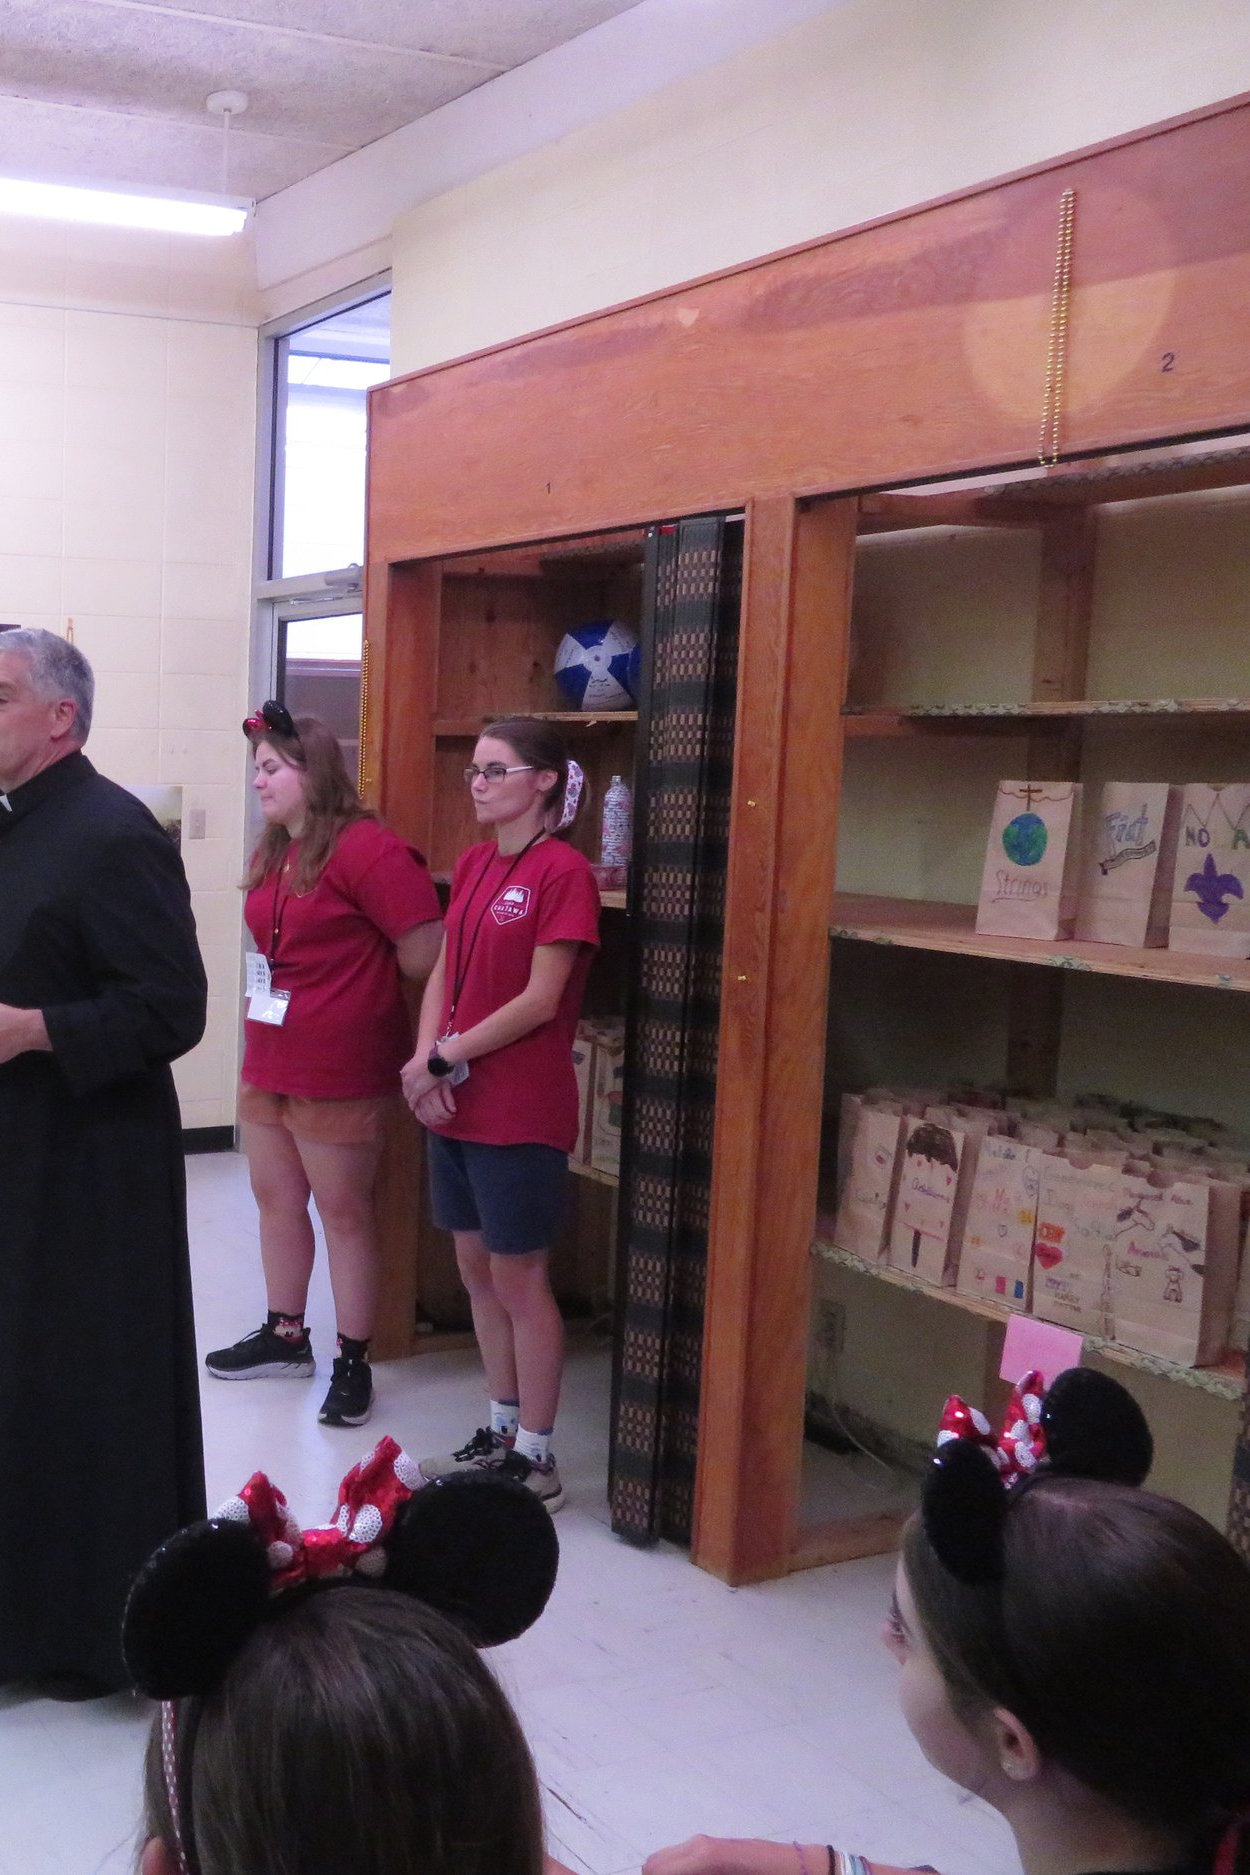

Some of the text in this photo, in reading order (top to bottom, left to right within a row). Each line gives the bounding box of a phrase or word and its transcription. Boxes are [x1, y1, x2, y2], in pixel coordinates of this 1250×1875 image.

[1161, 351, 1176, 373] 2
[545, 482, 552, 495] 1
[995, 869, 1048, 899] Strings
